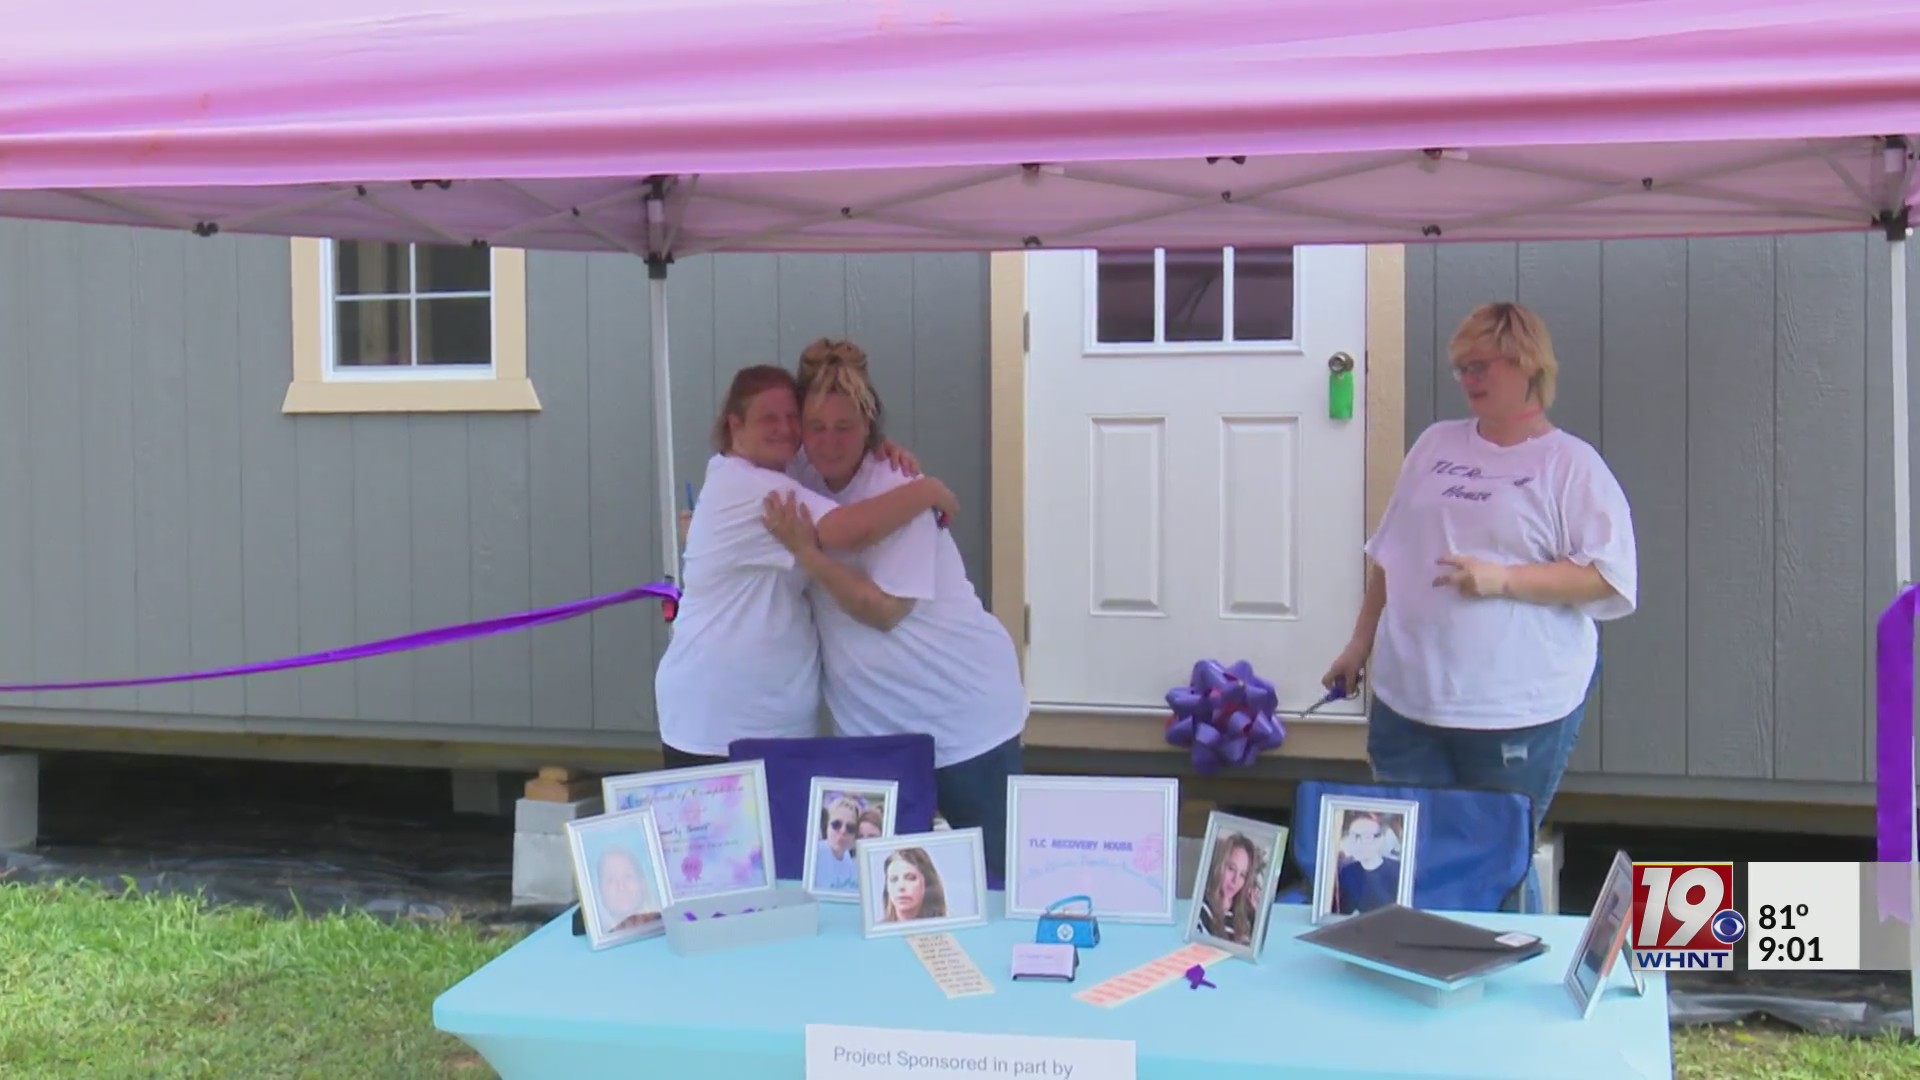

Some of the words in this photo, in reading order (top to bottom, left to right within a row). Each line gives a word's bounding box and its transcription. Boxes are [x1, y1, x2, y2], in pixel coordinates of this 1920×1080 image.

[1028, 838, 1047, 849] TLC
[1051, 839, 1099, 850] RECOVERY
[833, 1045, 892, 1069] Project
[896, 1049, 987, 1071] Sponsored
[993, 1056, 1008, 1072] in
[1013, 1059, 1048, 1077] part
[1052, 1059, 1074, 1079] by
